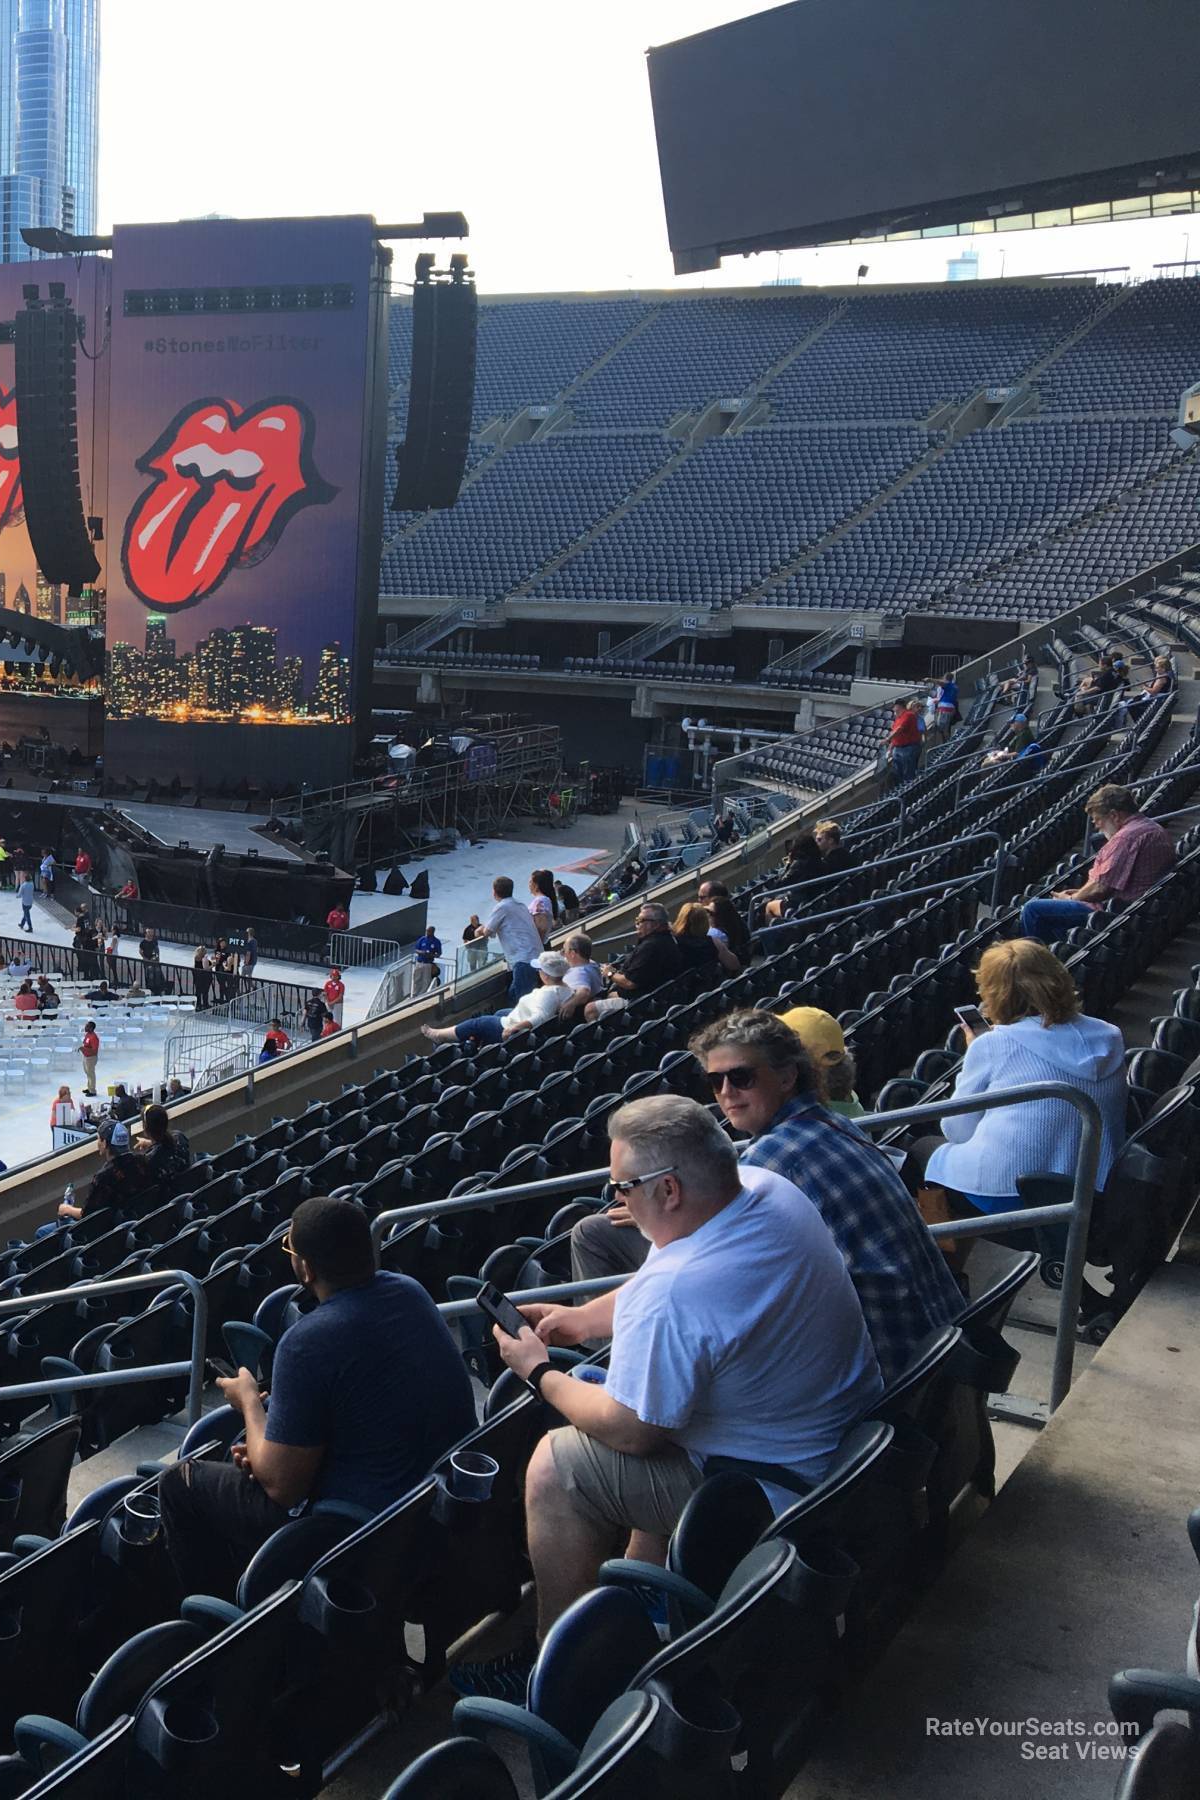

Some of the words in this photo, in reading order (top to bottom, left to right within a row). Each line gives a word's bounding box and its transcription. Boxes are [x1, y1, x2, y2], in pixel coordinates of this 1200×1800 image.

[143, 334, 324, 354] #StonesNoFilter
[684, 617, 696, 627] 154
[228, 937, 239, 945] PIT
